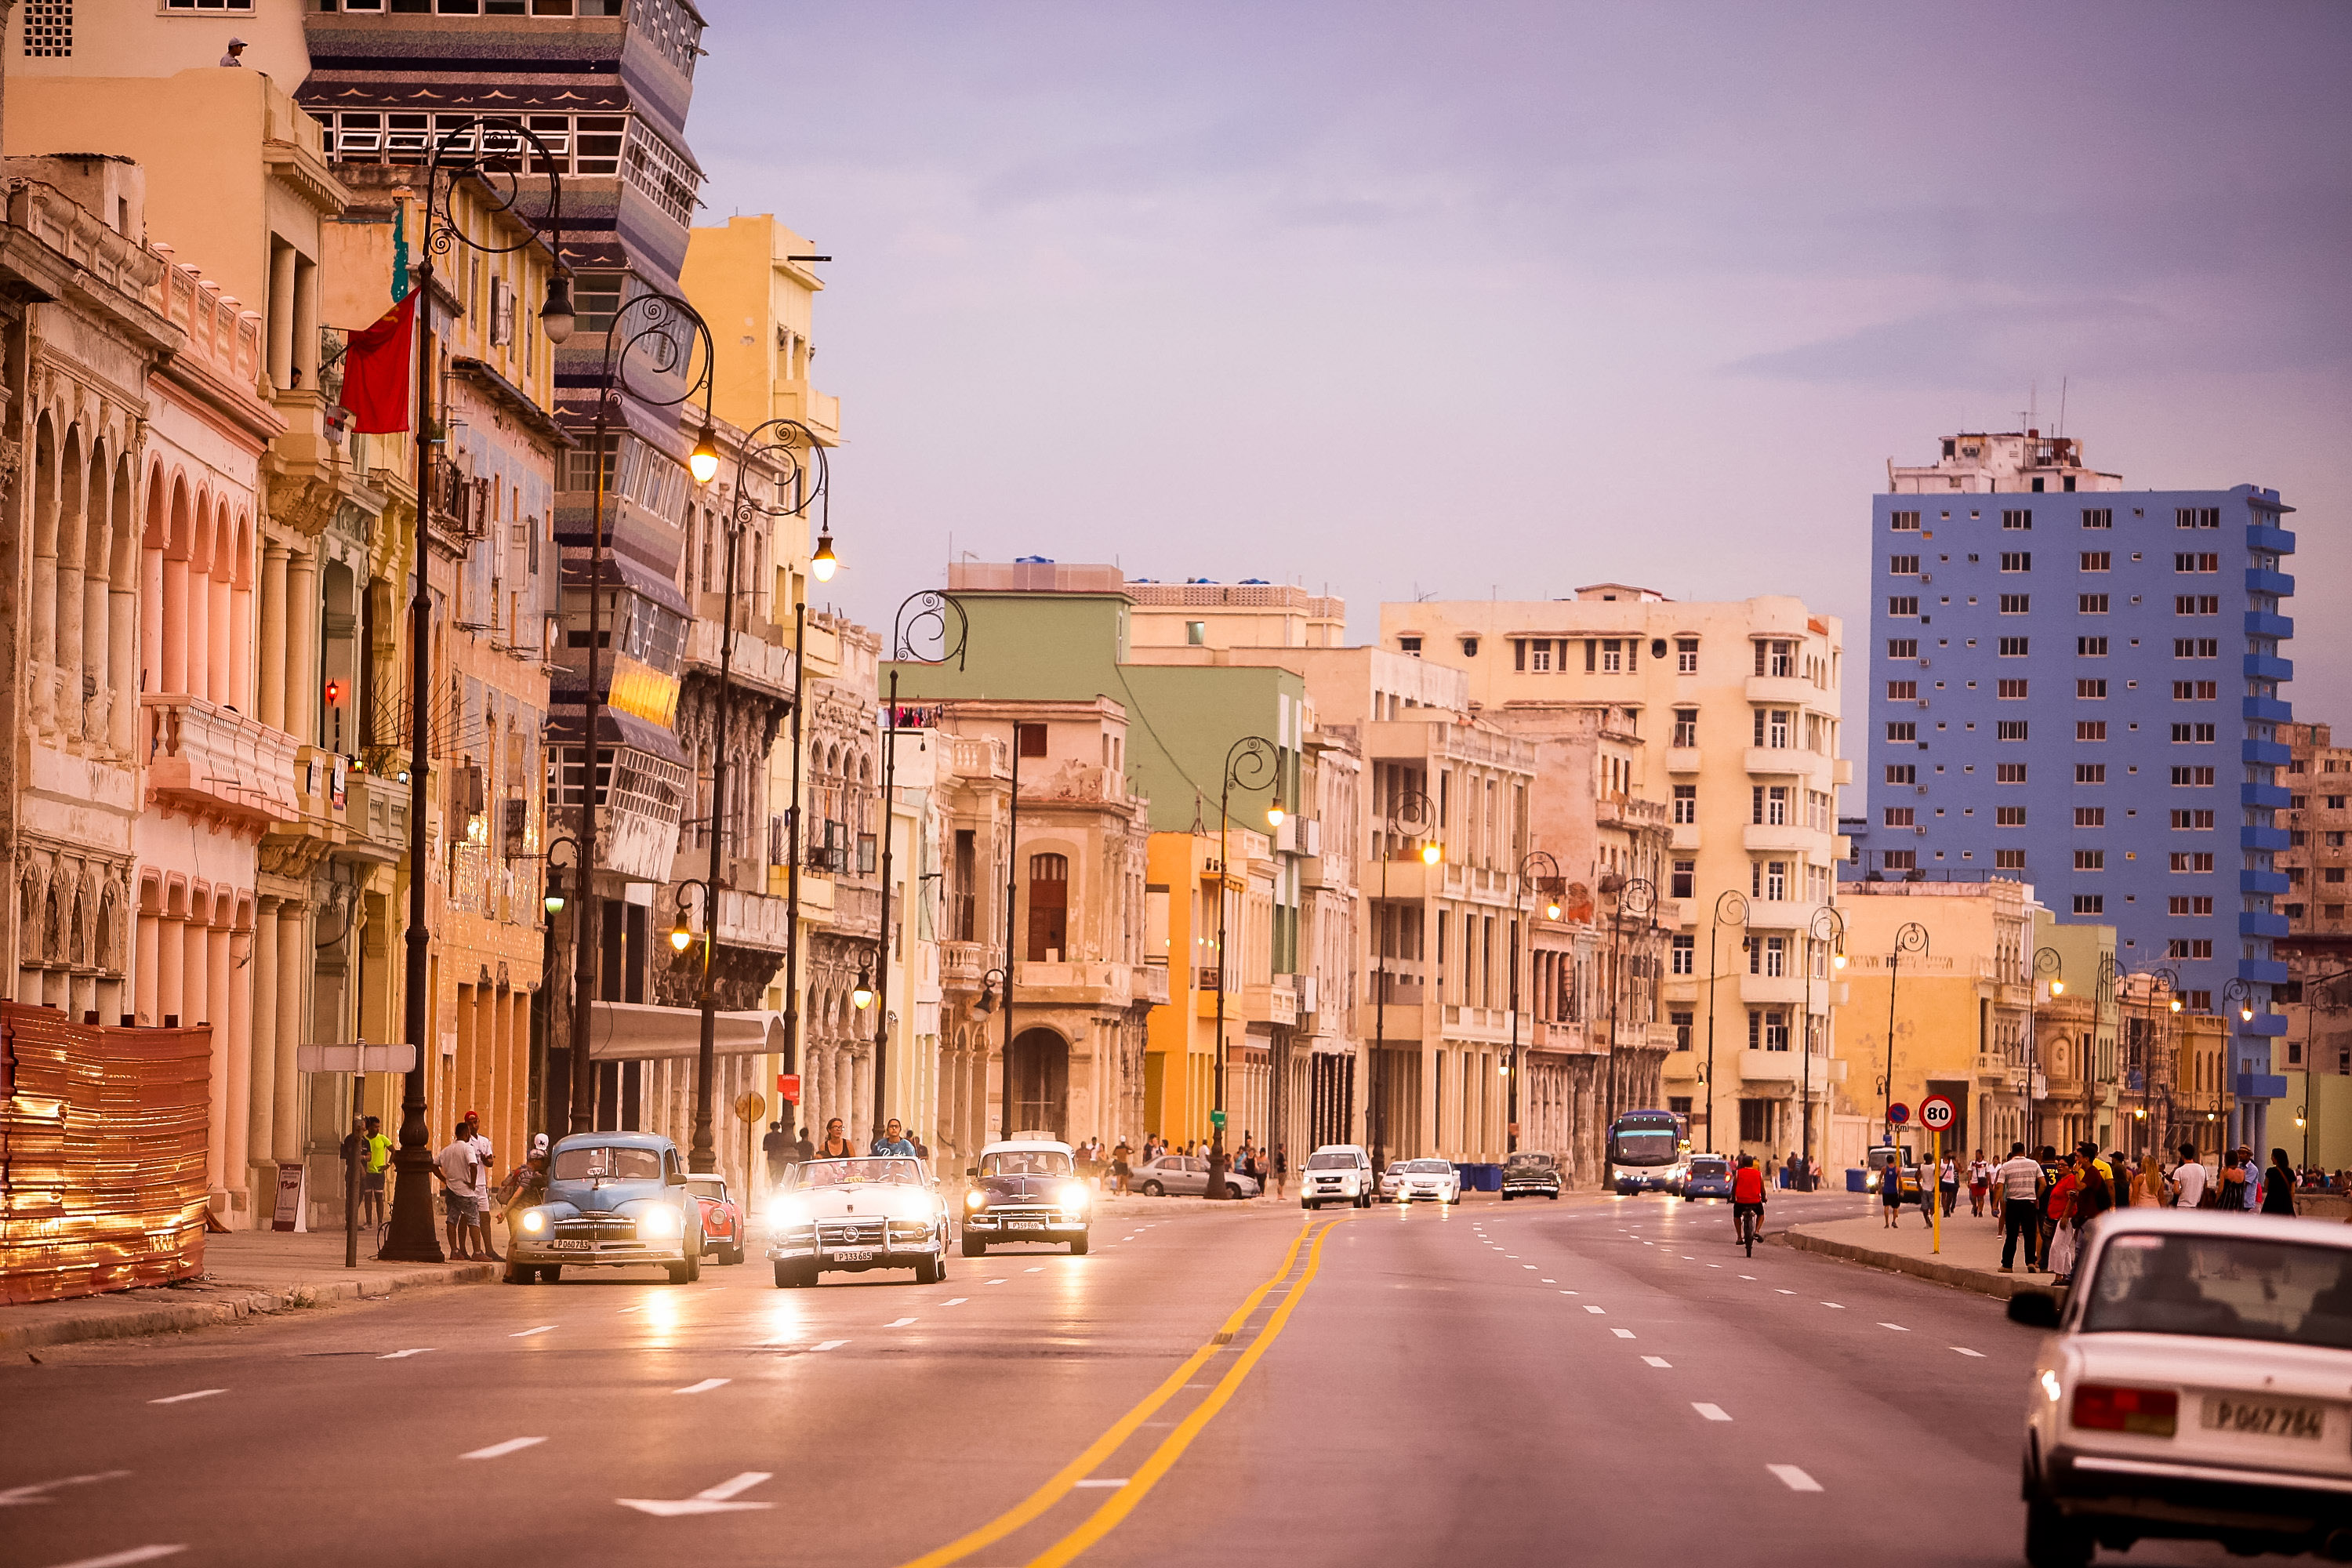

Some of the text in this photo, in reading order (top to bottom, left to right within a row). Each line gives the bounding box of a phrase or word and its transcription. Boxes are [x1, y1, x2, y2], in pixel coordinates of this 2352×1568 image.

[1927, 1107, 1949, 1120] 80
[2049, 1173, 2056, 1185] 3
[558, 1240, 588, 1249] P060783
[839, 1252, 871, 1261] P133685
